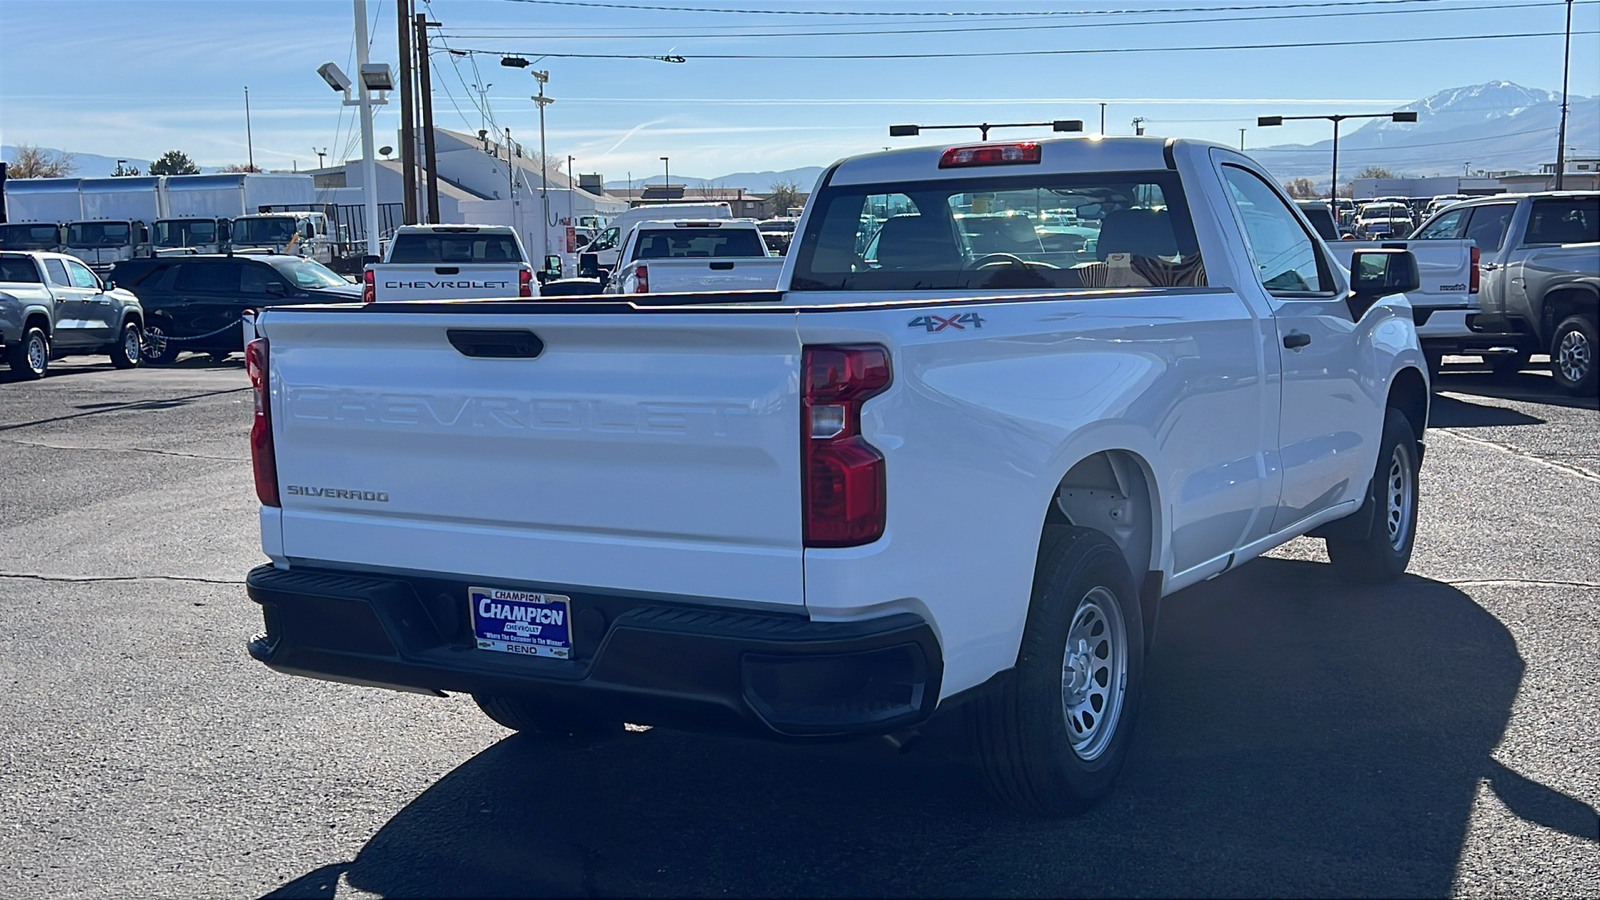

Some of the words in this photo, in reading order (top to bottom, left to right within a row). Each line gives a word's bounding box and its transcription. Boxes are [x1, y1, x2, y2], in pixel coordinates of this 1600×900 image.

[385, 281, 509, 289] CHEVROLET
[292, 389, 749, 437] CHEVROLET
[287, 485, 389, 502] SILVERADO
[494, 591, 542, 603] CHAMPION
[505, 623, 540, 633] CHEVROLET
[506, 644, 538, 655] RENO
